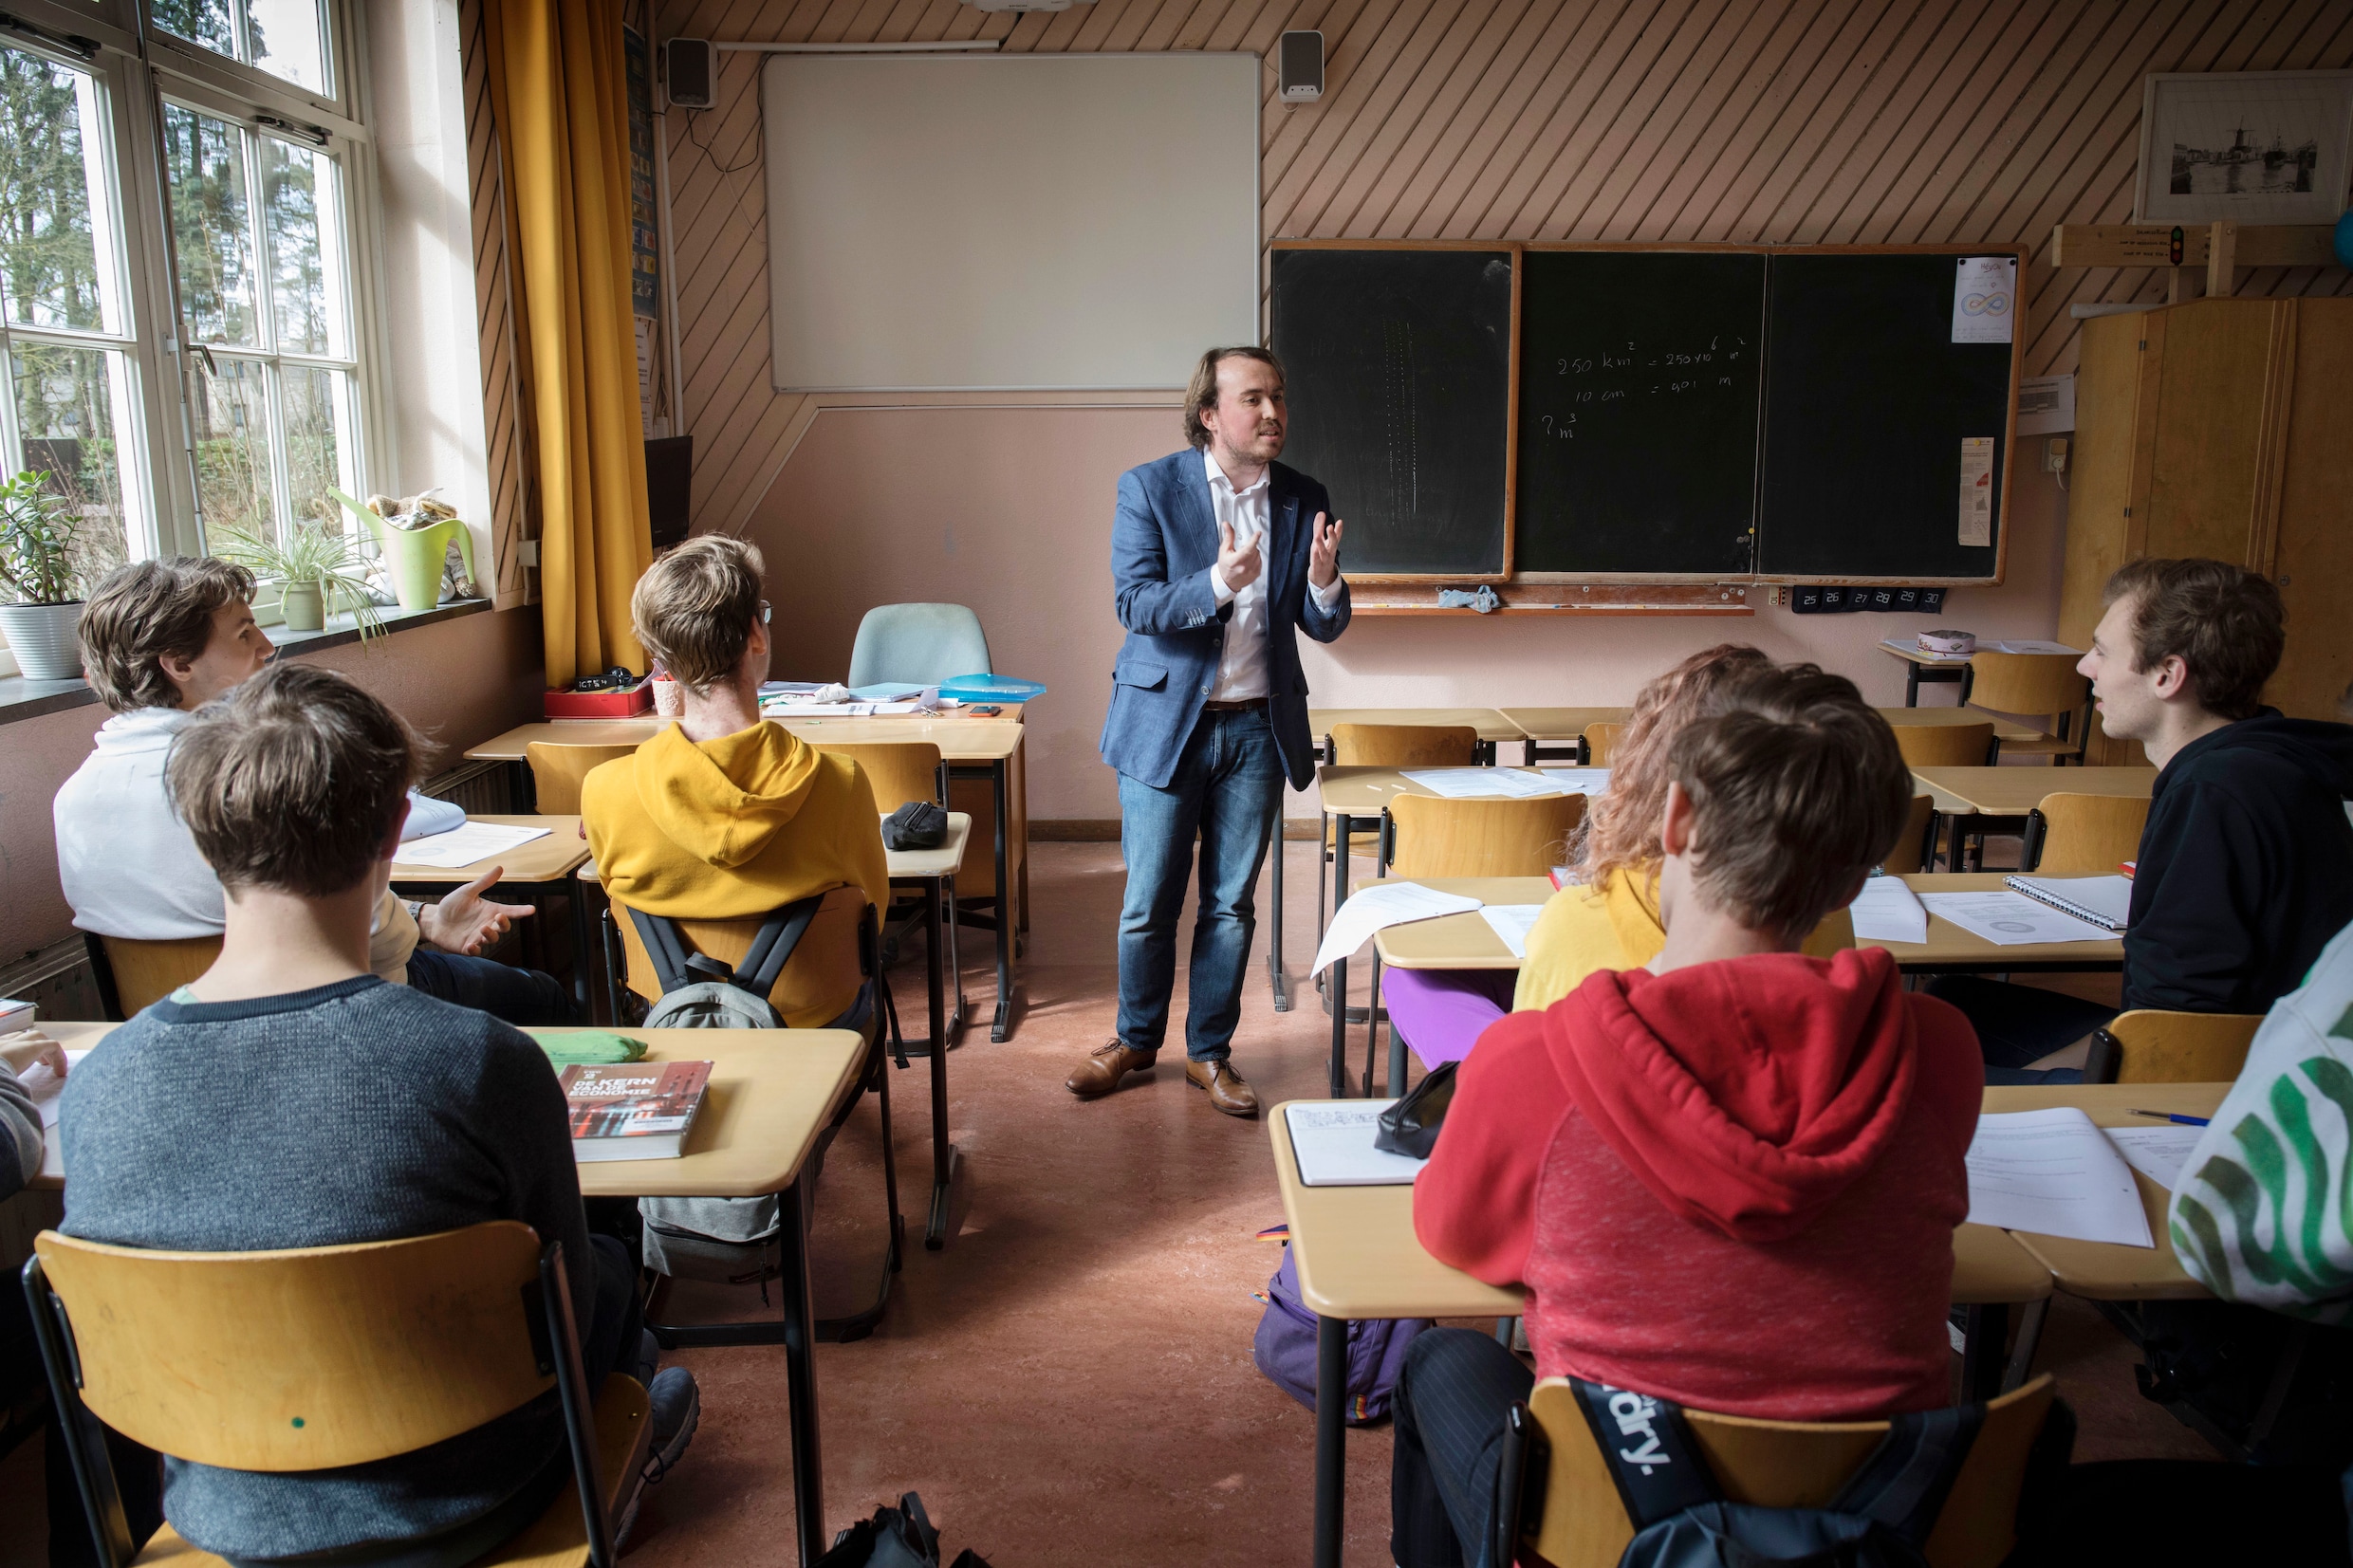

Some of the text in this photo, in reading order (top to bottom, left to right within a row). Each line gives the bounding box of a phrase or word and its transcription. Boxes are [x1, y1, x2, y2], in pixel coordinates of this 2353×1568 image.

[1557, 359, 1592, 375] 250
[1575, 391, 1592, 402] 10
[1804, 590, 1938, 605] 25 26 27 28 29 30
[599, 1078, 657, 1086] KERN
[568, 1088, 651, 1097] ECONOMIE
